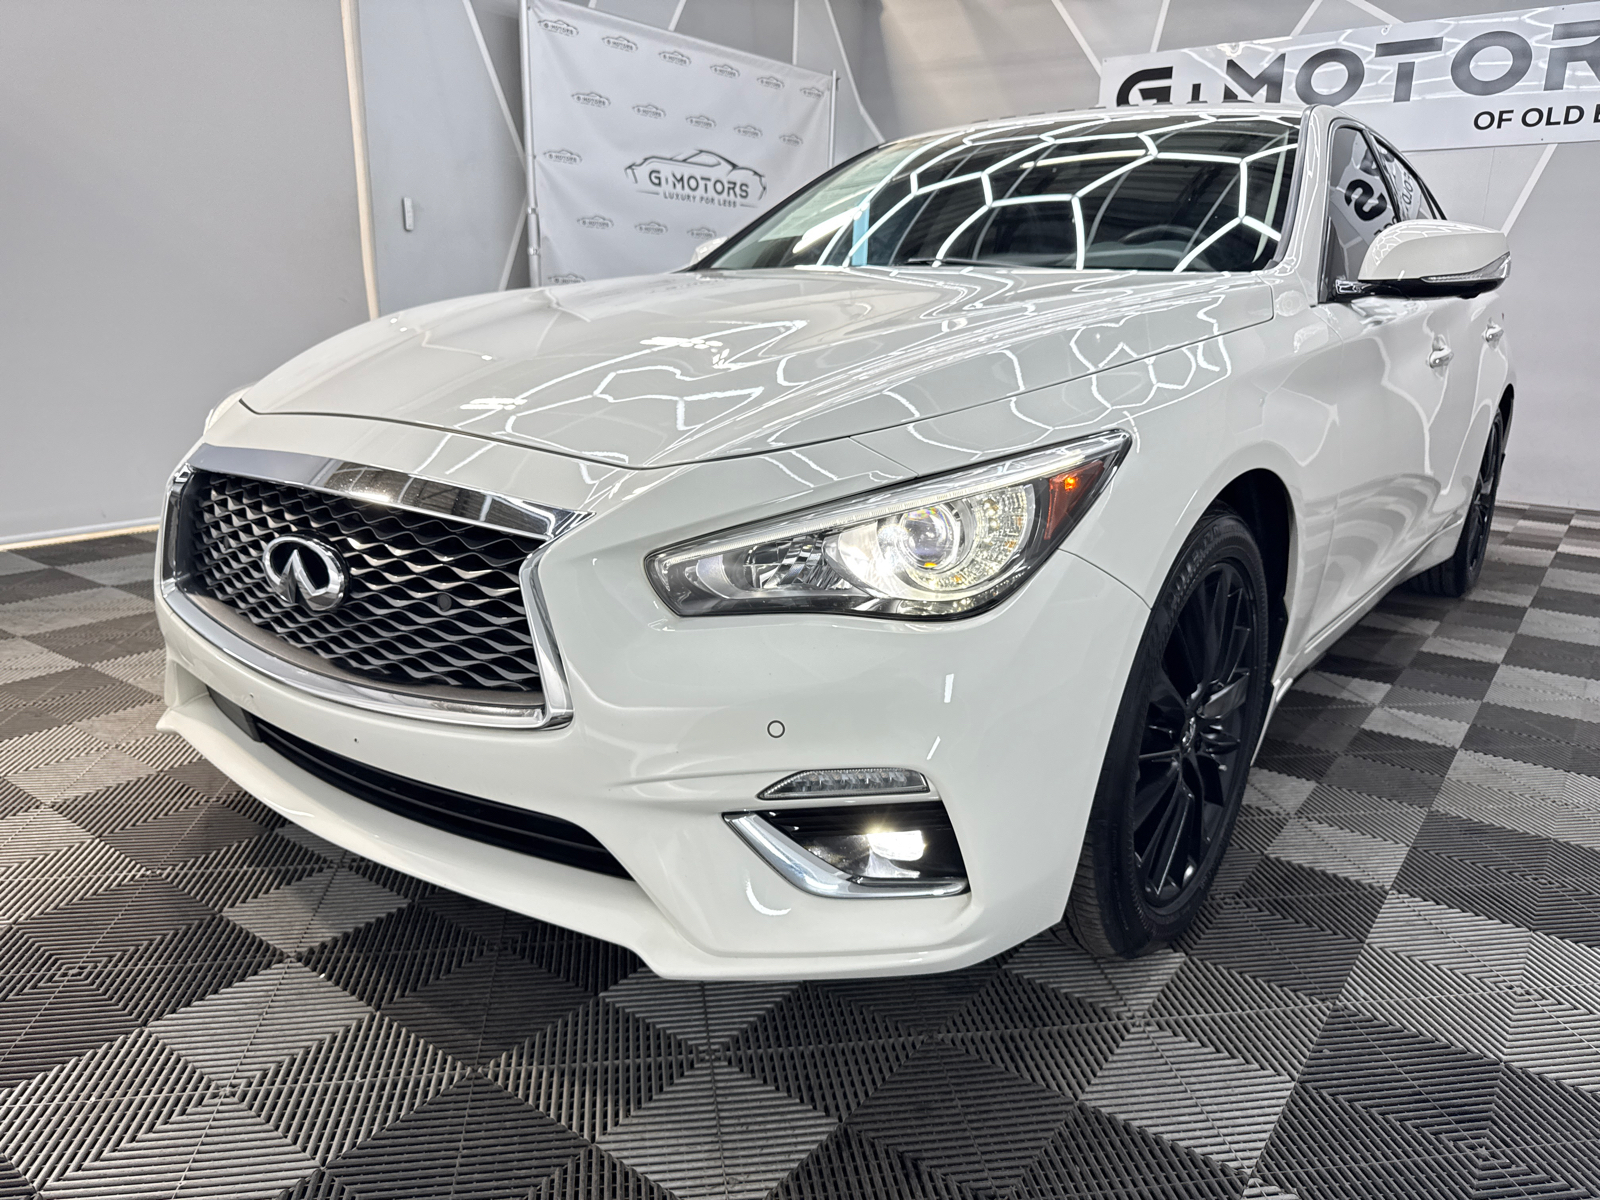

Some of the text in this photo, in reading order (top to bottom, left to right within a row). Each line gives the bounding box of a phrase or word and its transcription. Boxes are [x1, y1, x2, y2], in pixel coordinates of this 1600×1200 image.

[1473, 109, 1514, 131] OF
[1521, 104, 1585, 127] OLD
[663, 190, 737, 208] LUXURY FOR LESS
